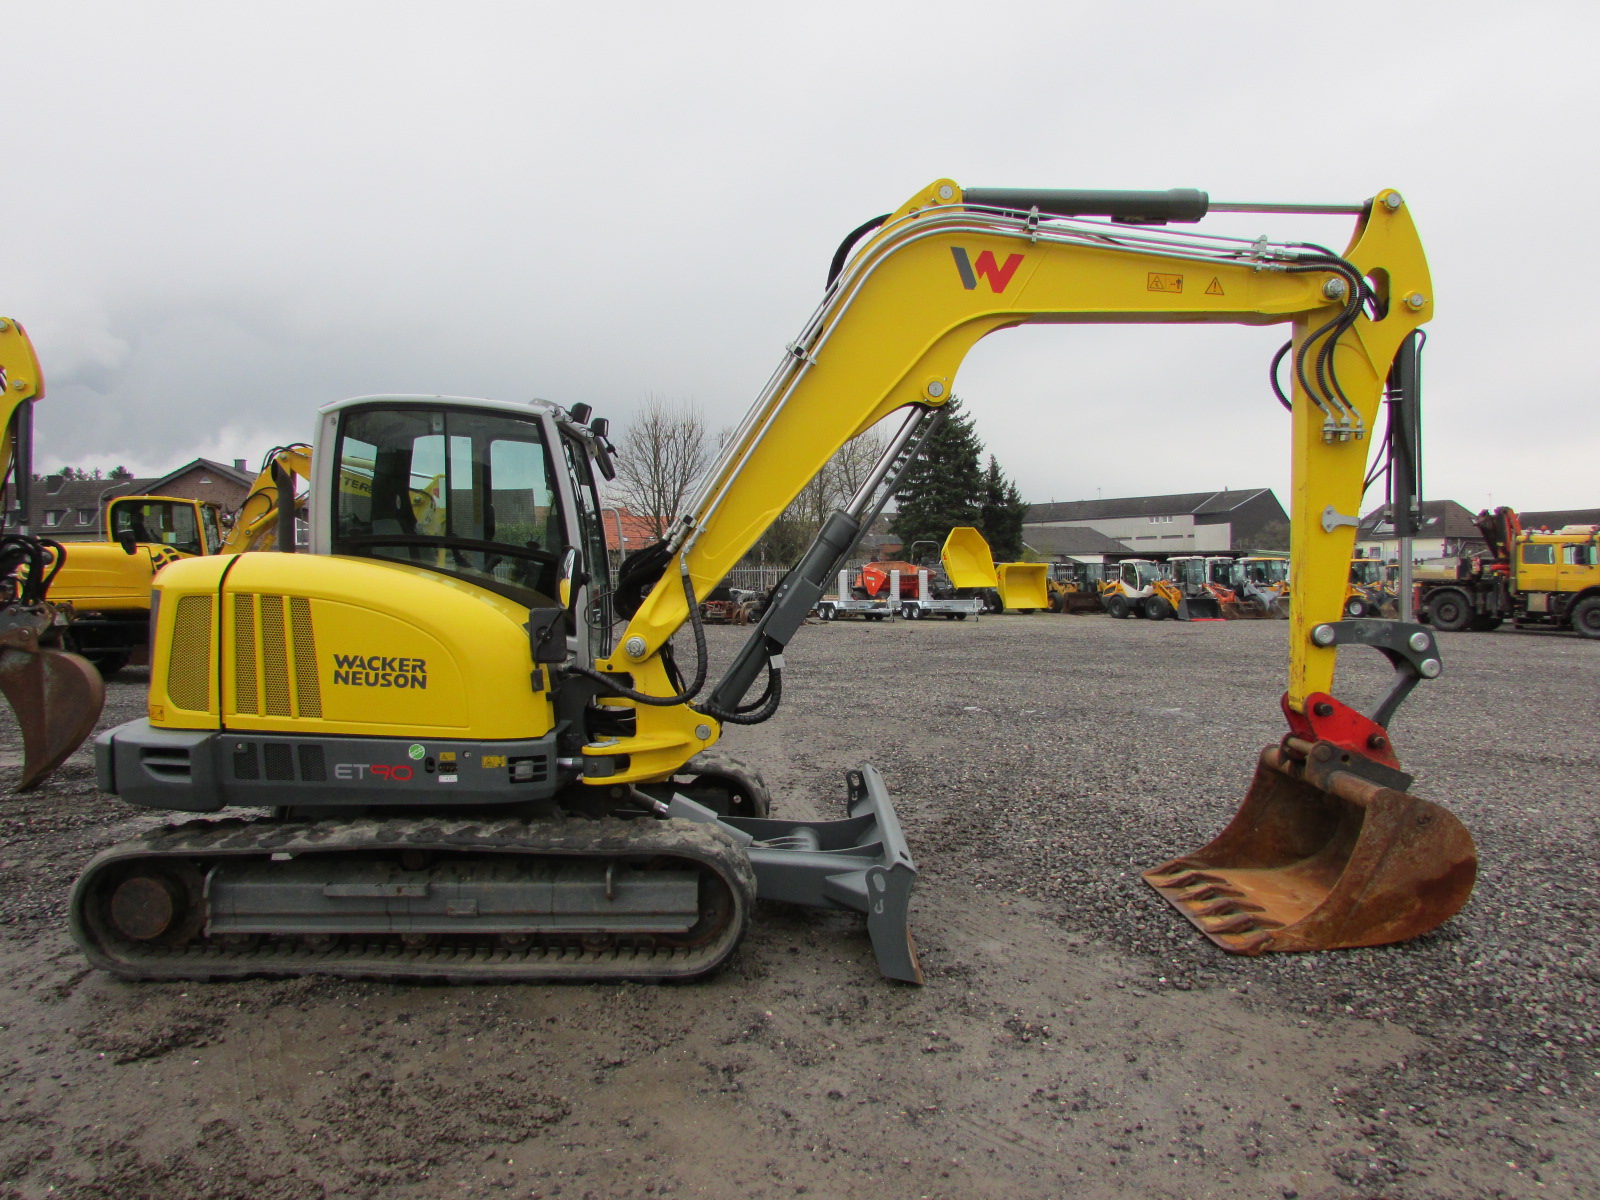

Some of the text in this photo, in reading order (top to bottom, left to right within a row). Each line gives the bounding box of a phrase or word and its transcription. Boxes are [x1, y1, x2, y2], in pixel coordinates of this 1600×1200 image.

[333, 654, 427, 673] WACKER
[334, 670, 427, 689] NEUSON
[335, 763, 413, 780] ET90
